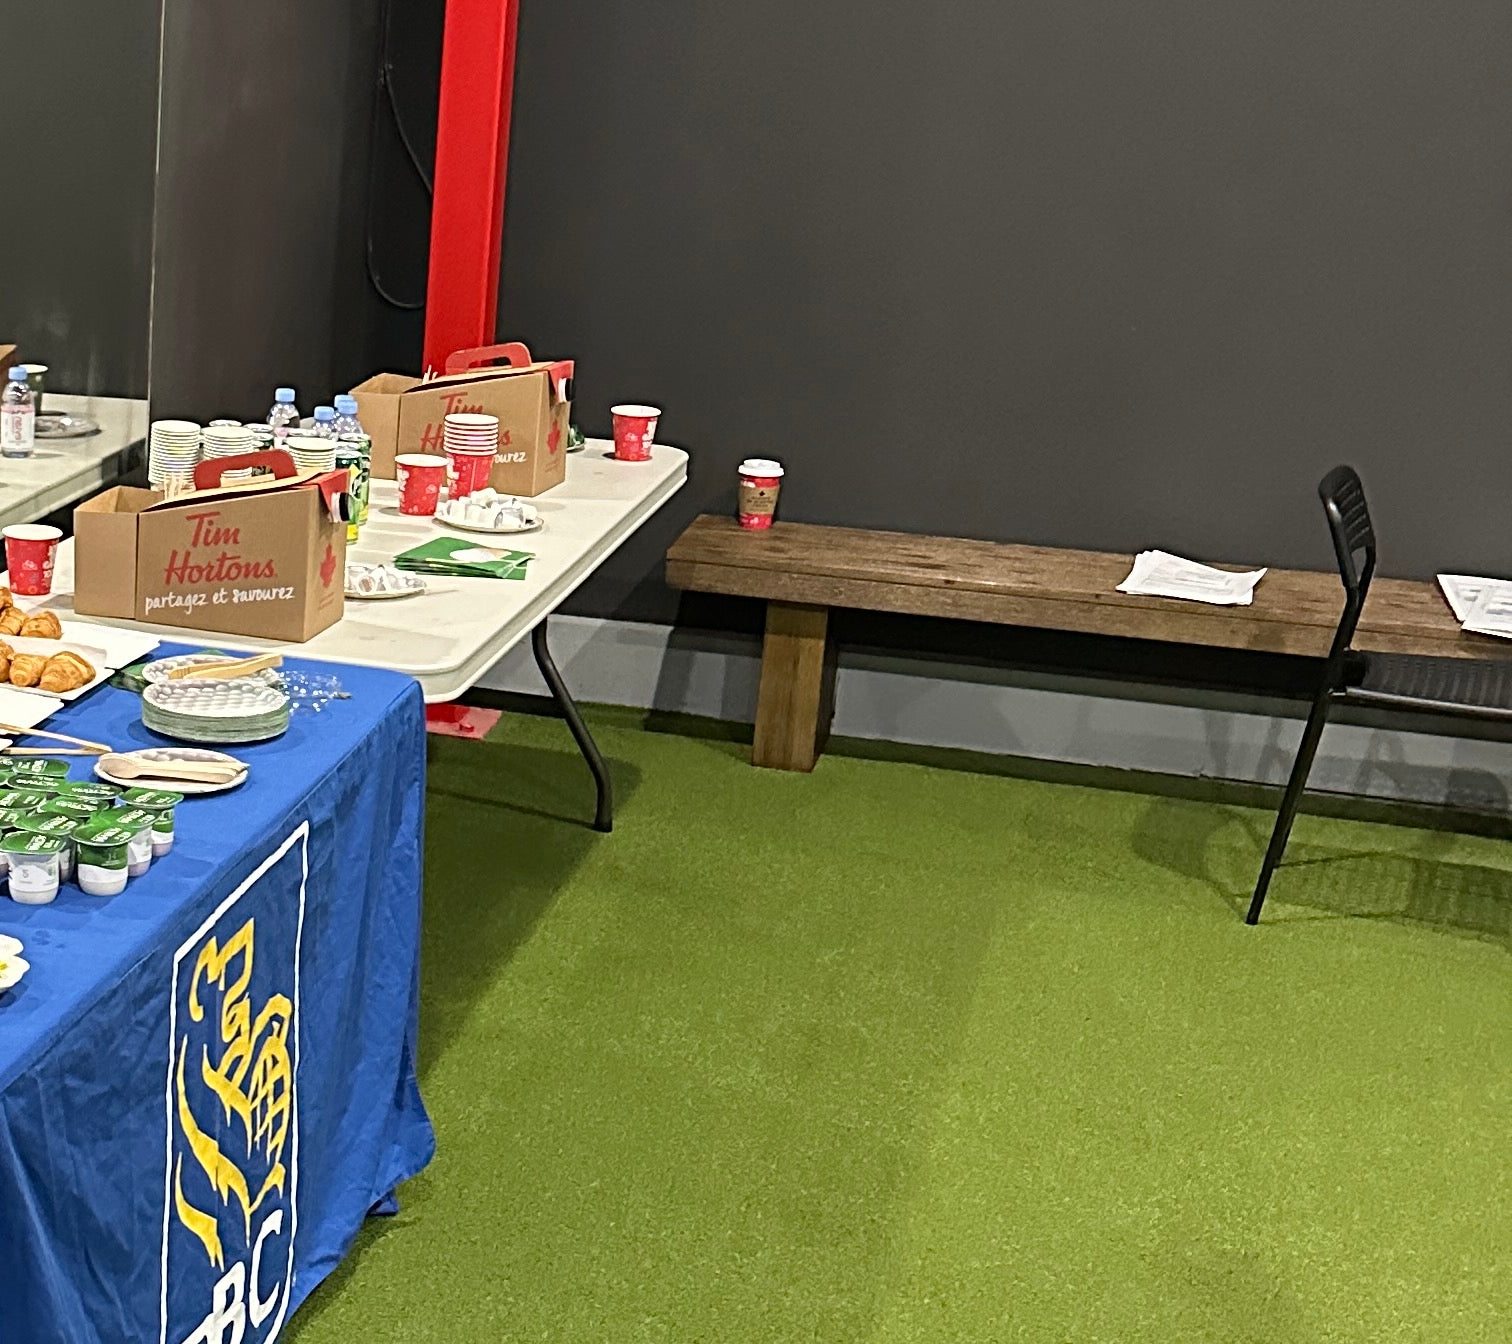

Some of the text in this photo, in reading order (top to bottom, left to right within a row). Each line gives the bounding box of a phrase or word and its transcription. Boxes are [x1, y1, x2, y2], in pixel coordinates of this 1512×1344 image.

[185, 511, 240, 548] Tim
[164, 549, 275, 586] Hortons
[145, 586, 295, 615] partagez et savourez
